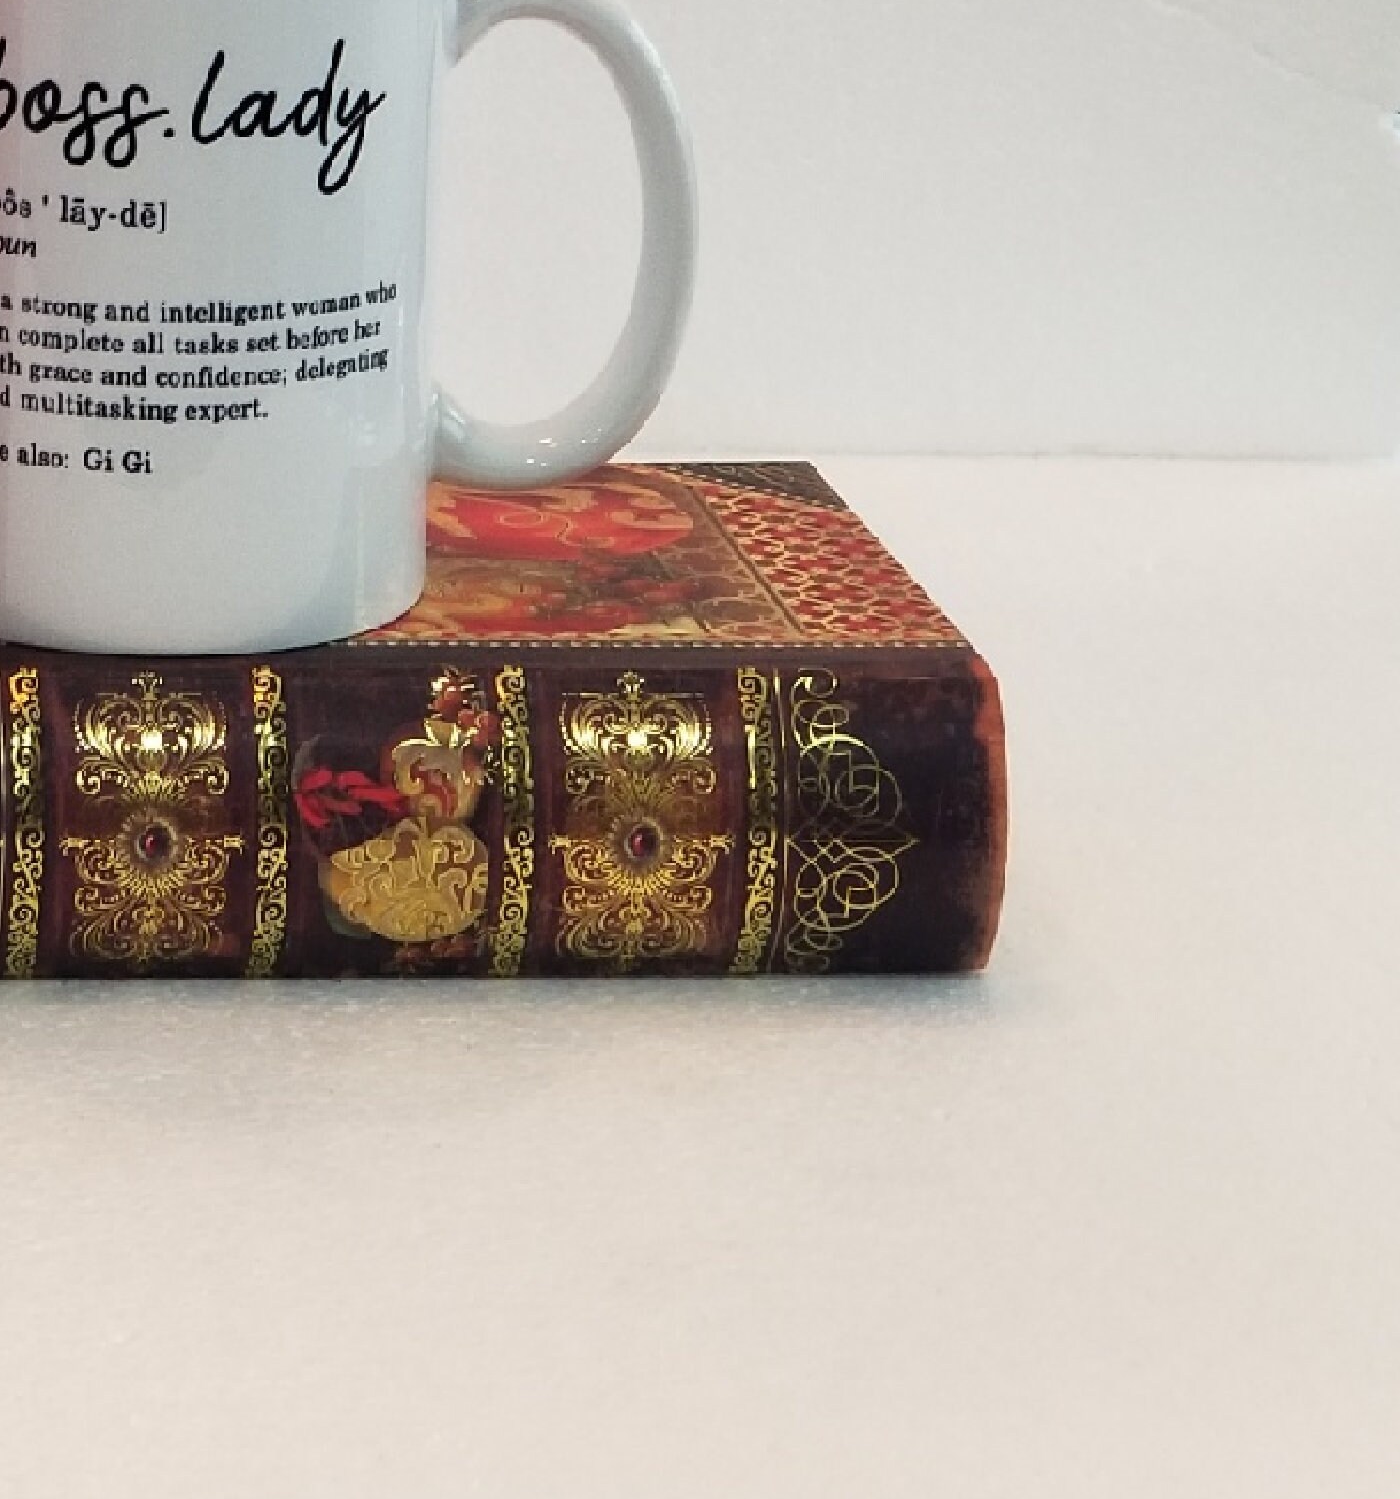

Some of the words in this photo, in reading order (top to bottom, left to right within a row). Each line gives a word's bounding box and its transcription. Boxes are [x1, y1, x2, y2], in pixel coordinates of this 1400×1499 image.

[0, 293, 13, 311] a
[21, 294, 98, 326] strong
[104, 299, 150, 323] and
[160, 300, 287, 327] intelligent
[290, 293, 362, 317] woman
[365, 279, 397, 304] who
[17, 327, 125, 354] complete
[131, 331, 164, 354] all
[174, 331, 239, 354] tasks
[246, 332, 281, 354] set
[285, 325, 349, 350] before
[354, 318, 381, 342] her
[29, 362, 94, 384] grace
[100, 364, 147, 387] and
[155, 364, 287, 388] confidence;
[294, 348, 390, 382] delegating
[20, 391, 179, 425] multitasking
[184, 397, 270, 425] expert.
[16, 441, 70, 469] also:
[83, 446, 115, 474] Gi
[122, 449, 153, 474] Gi
